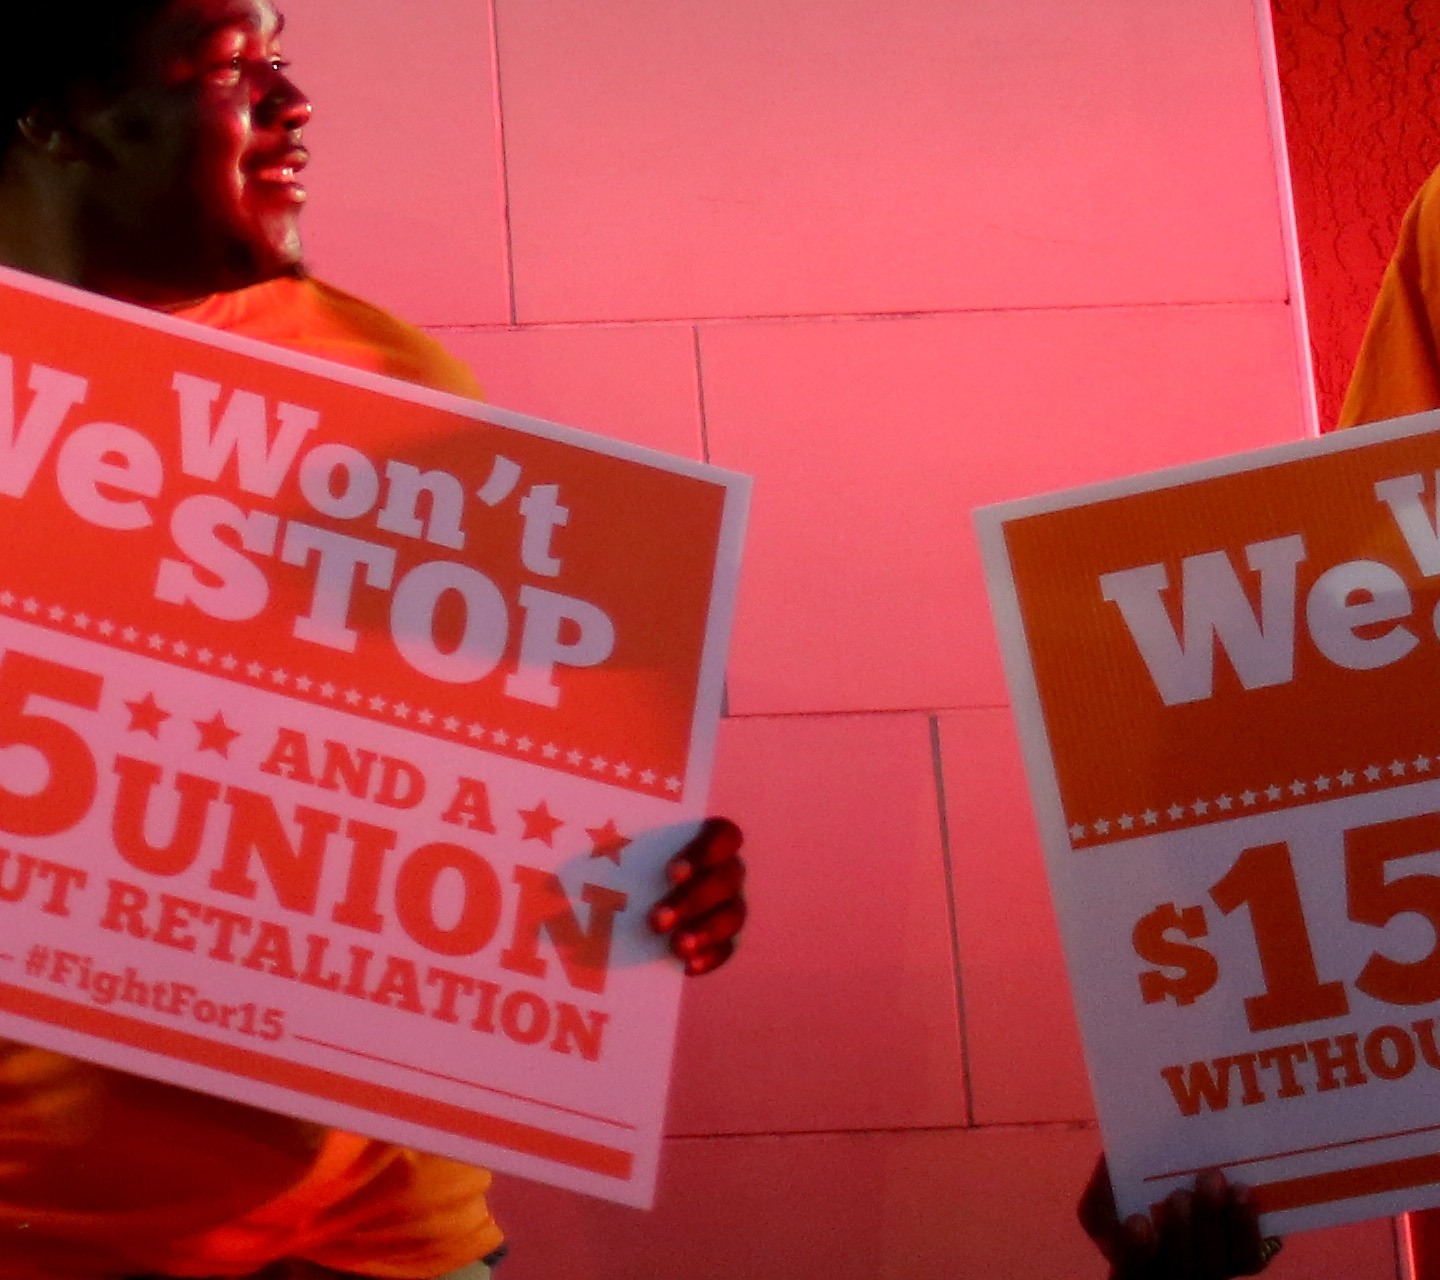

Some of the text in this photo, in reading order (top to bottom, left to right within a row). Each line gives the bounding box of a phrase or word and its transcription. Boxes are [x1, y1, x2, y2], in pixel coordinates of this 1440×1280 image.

[171, 372, 571, 577] Won't
[154, 493, 616, 709] STOP
[1101, 532, 1421, 709] We
[259, 726, 497, 834] AND A
[111, 755, 629, 995] UNION
[25, 942, 287, 1041] #FightFor15
[99, 877, 608, 1063] RETALIATION
